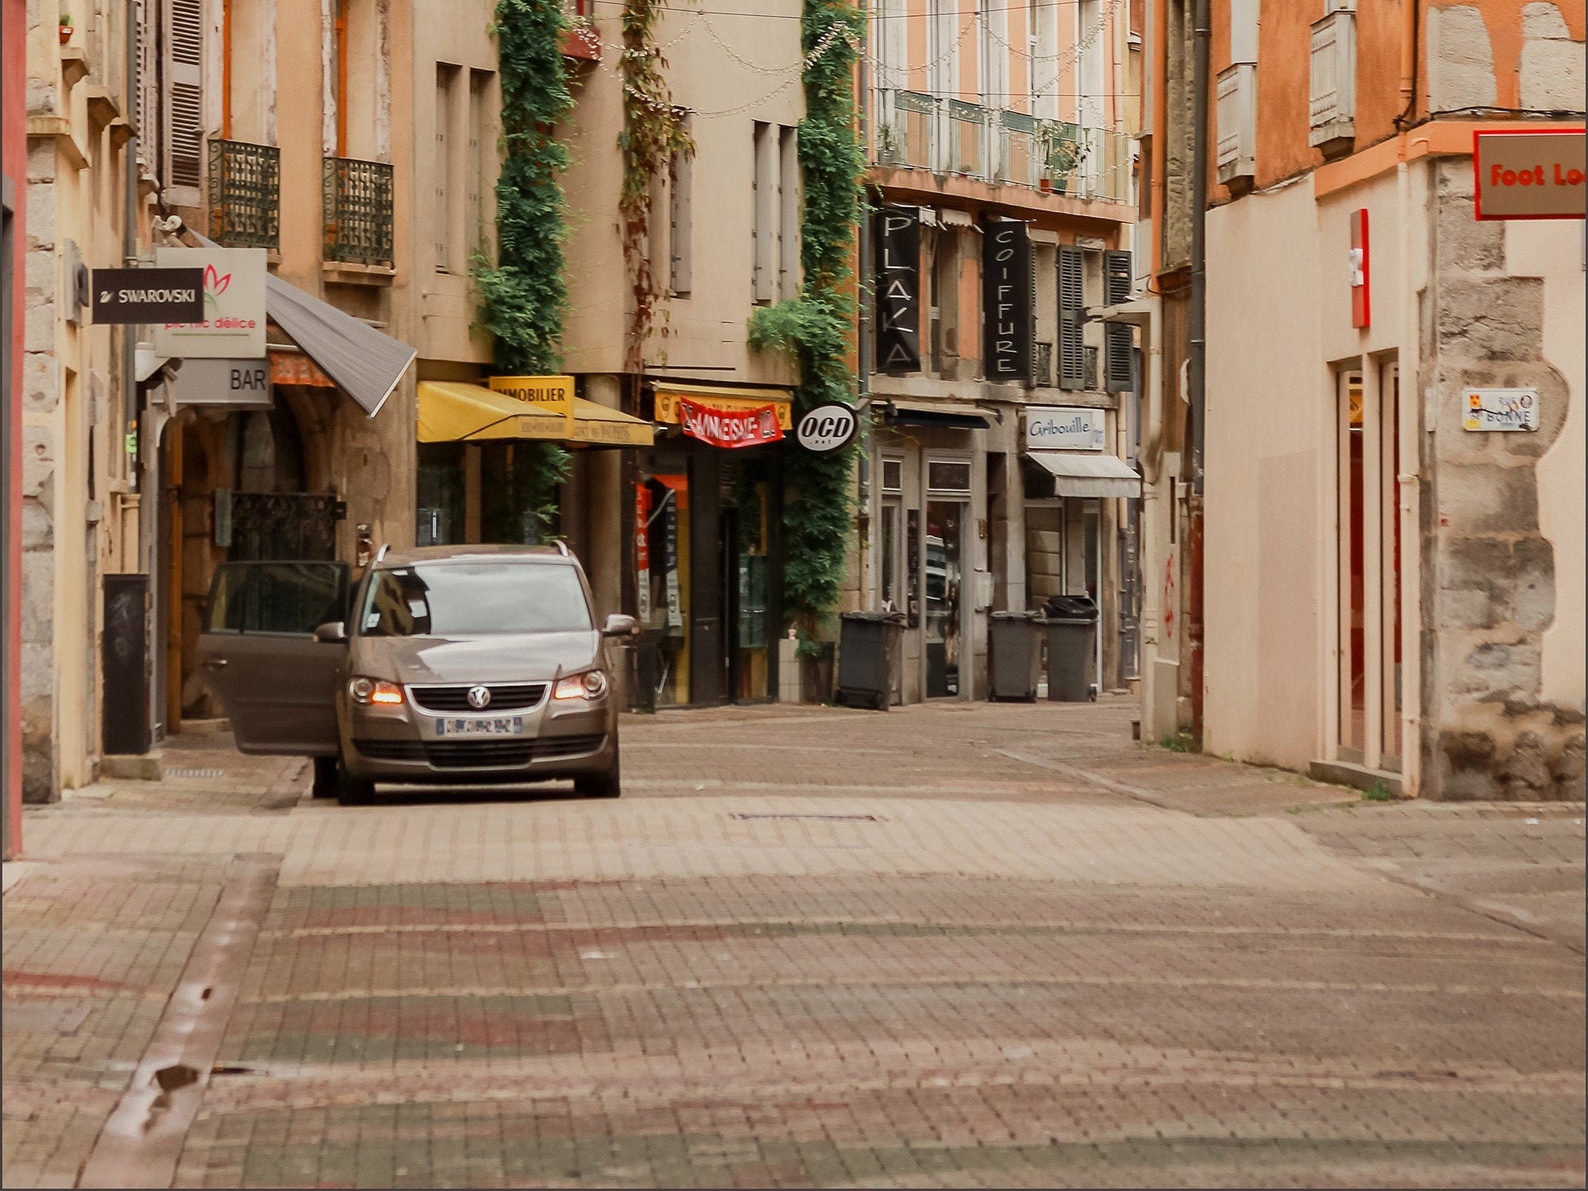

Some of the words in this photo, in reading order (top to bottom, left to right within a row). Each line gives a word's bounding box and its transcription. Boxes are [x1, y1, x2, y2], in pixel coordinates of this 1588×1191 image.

[1491, 164, 1545, 186] Foot
[118, 289, 196, 303] SWAROVSKI
[884, 216, 916, 364] PLAKA
[995, 230, 1018, 372] COIFFURE
[214, 317, 256, 329] délice
[230, 369, 267, 390] BAR
[494, 388, 565, 402] MOBILIER
[801, 417, 851, 438] OCD
[1029, 416, 1090, 437] Gribouille
